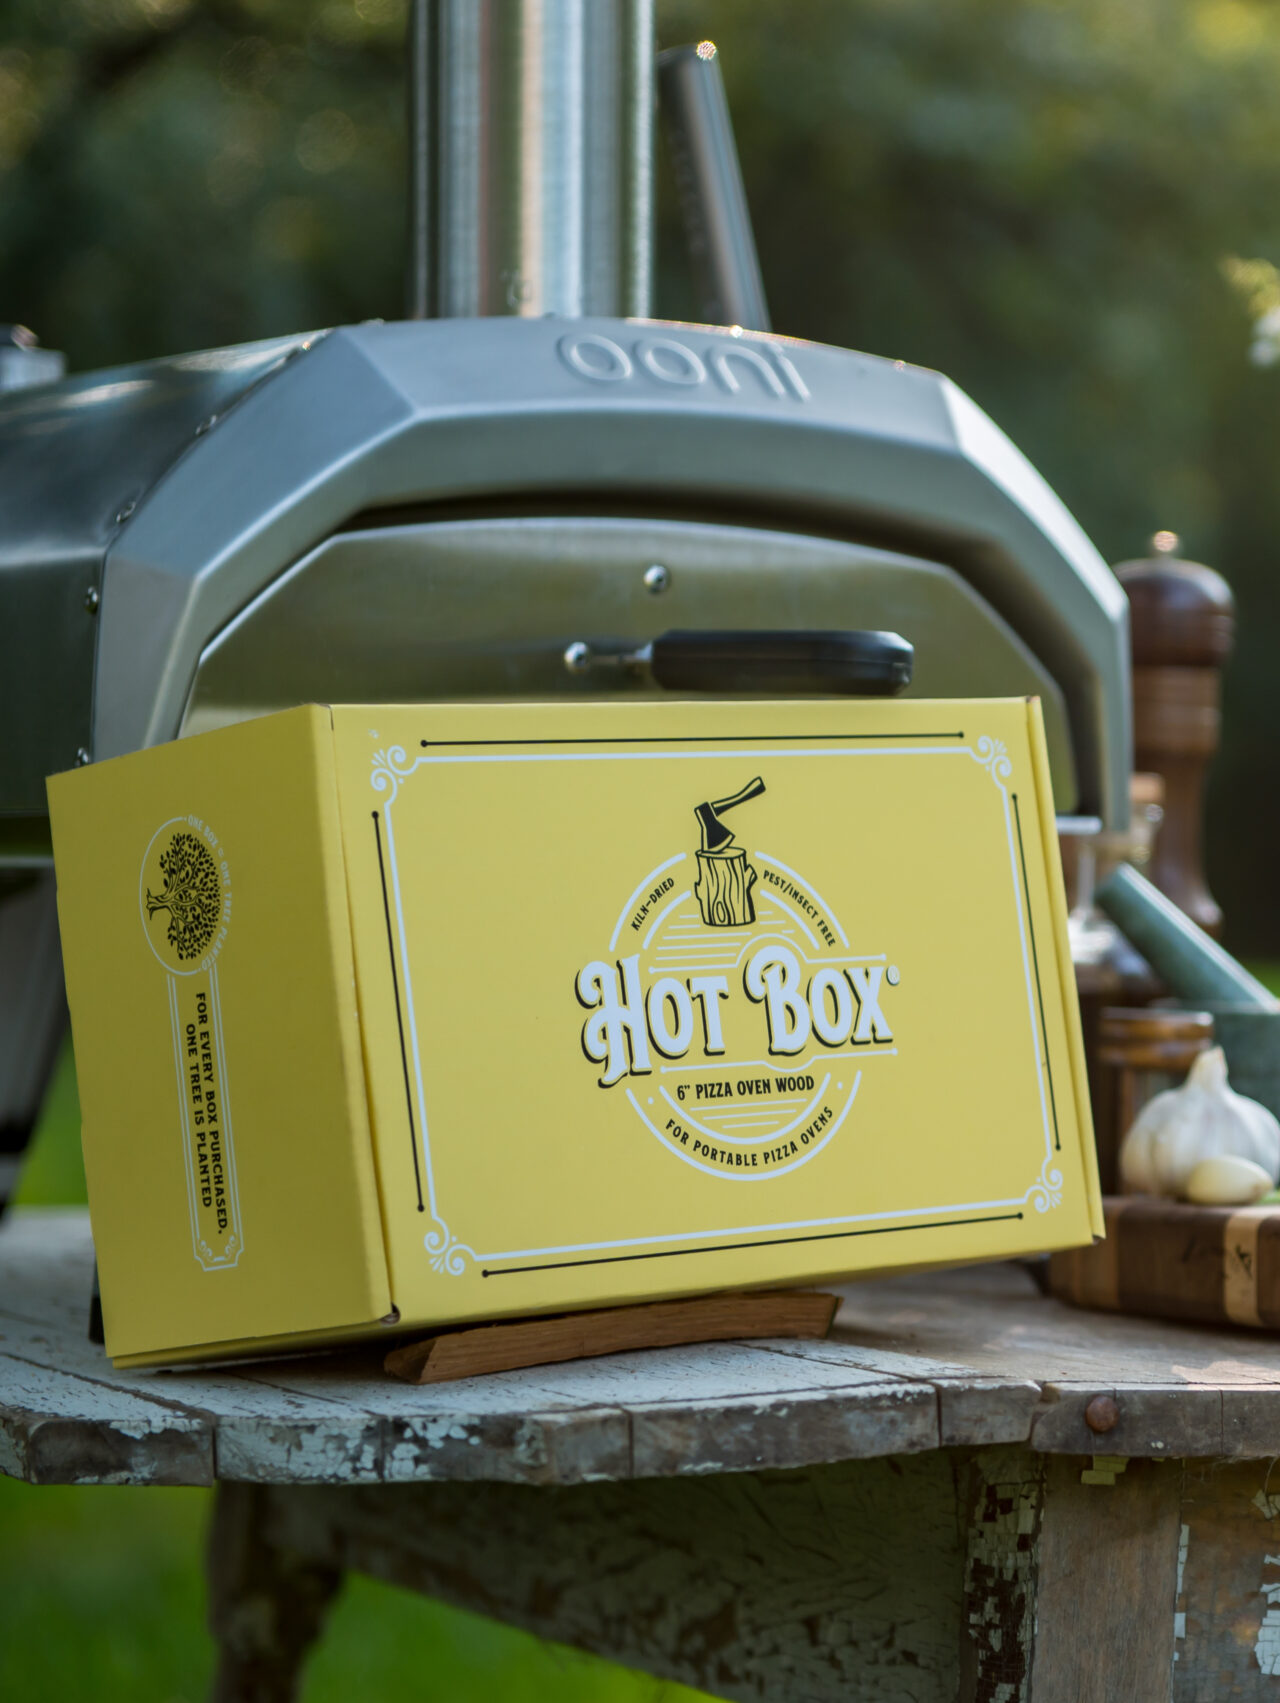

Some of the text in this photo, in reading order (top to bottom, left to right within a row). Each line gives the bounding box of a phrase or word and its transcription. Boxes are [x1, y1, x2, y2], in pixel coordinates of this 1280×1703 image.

[555, 333, 811, 402] ooni
[187, 814, 204, 831] ONE
[203, 825, 219, 848] BOX
[221, 861, 231, 887] ONE
[223, 892, 232, 923] TREE
[631, 877, 675, 932] KILN-DRIED
[763, 869, 836, 947] PEST/INSECT FREE
[202, 926, 228, 971] PLANTED
[575, 953, 729, 1089] HOT
[196, 992, 228, 1235] FOR EVERY BOX PURCHASED.
[695, 1082, 733, 1099] PIZZA
[736, 1078, 771, 1096] OVEN
[775, 1075, 815, 1093] WOOD
[186, 1023, 212, 1207] ONE TREE IS PLANTED
[665, 1106, 833, 1167] FOR PORTABLE PIZZA OVENS
